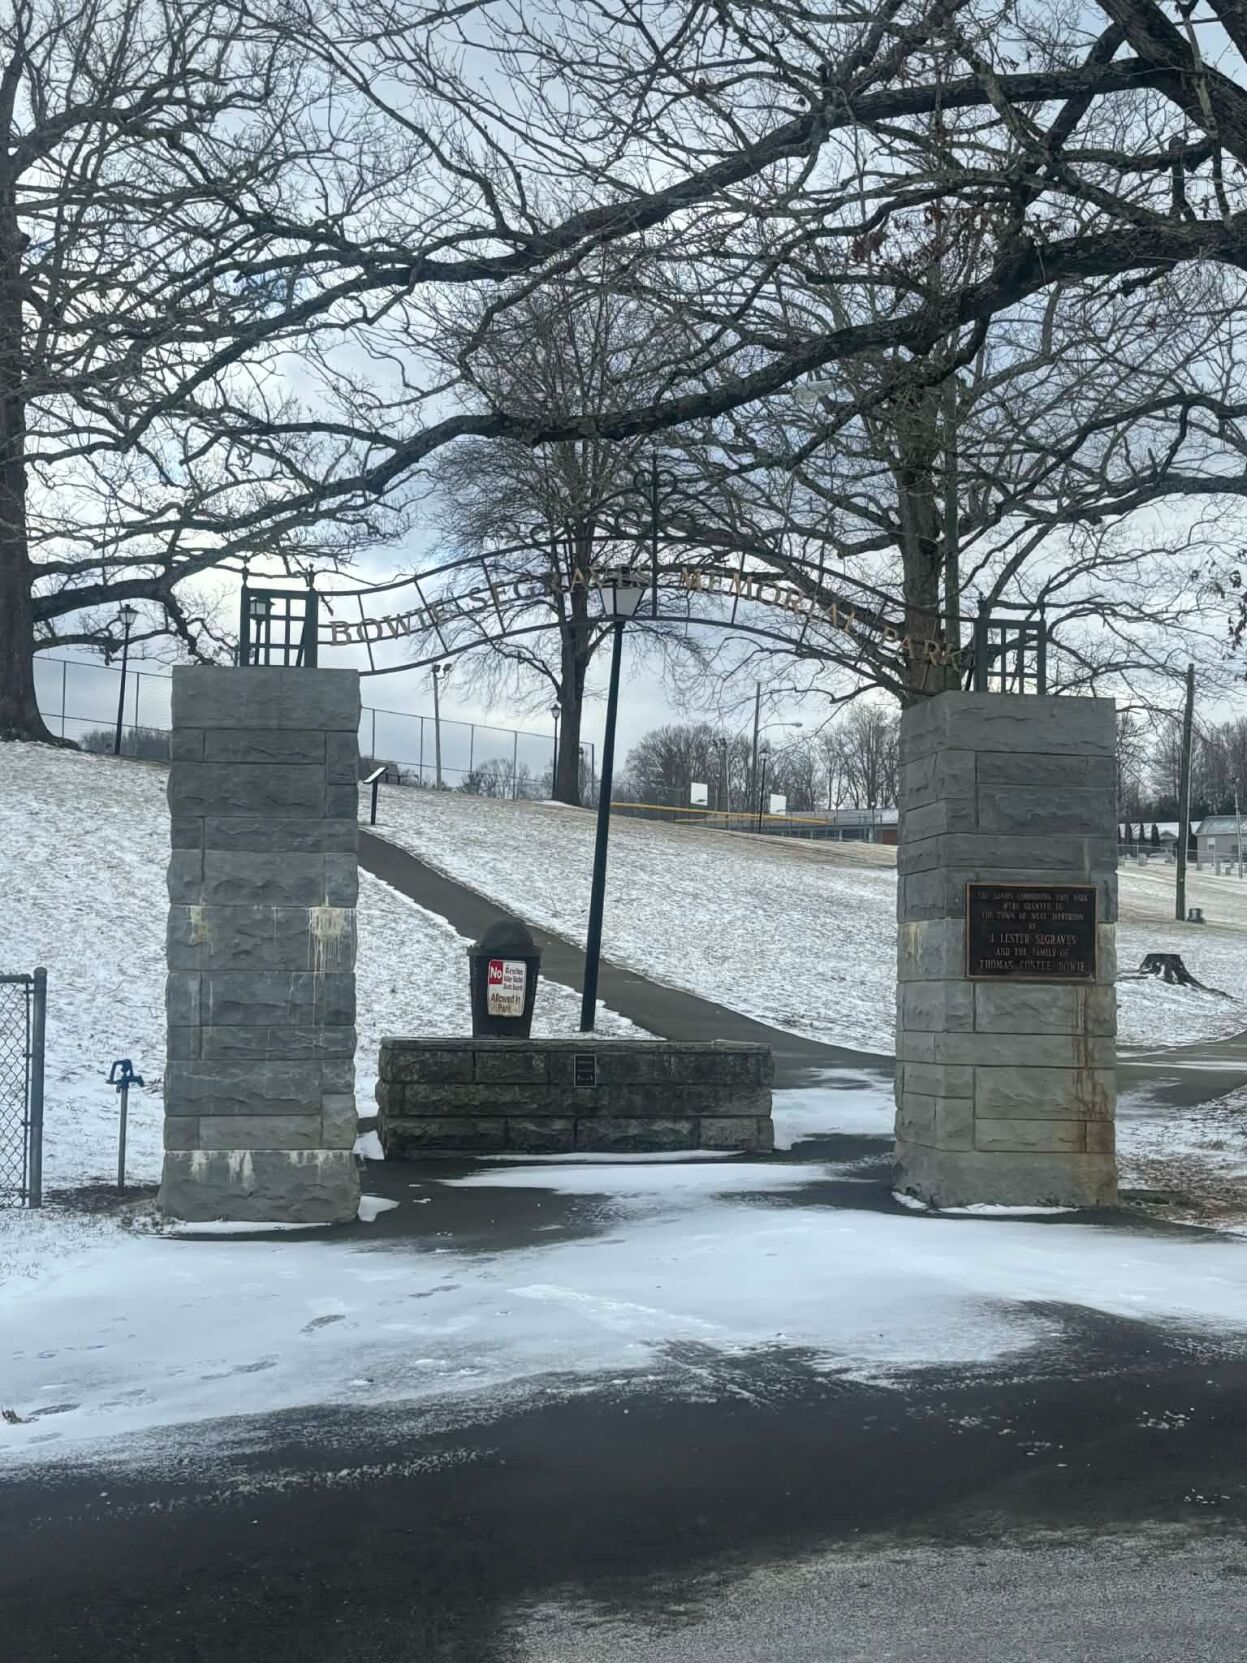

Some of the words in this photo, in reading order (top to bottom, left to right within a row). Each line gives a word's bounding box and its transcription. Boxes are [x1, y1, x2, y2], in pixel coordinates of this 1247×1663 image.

[329, 598, 455, 647] BOWIE
[681, 567, 858, 636] MEMORIAL
[877, 626, 963, 673] PARK
[1000, 932, 1030, 945] LESTER
[1035, 933, 1078, 946] SEGRAVES
[995, 947, 1011, 957] AND
[1014, 947, 1027, 957] THE
[1032, 947, 1057, 958] FAMILY
[979, 959, 1014, 970] THOMAS
[490, 966, 502, 979] No
[491, 993, 515, 1003] Allowed
[497, 1003, 512, 1014] Park
